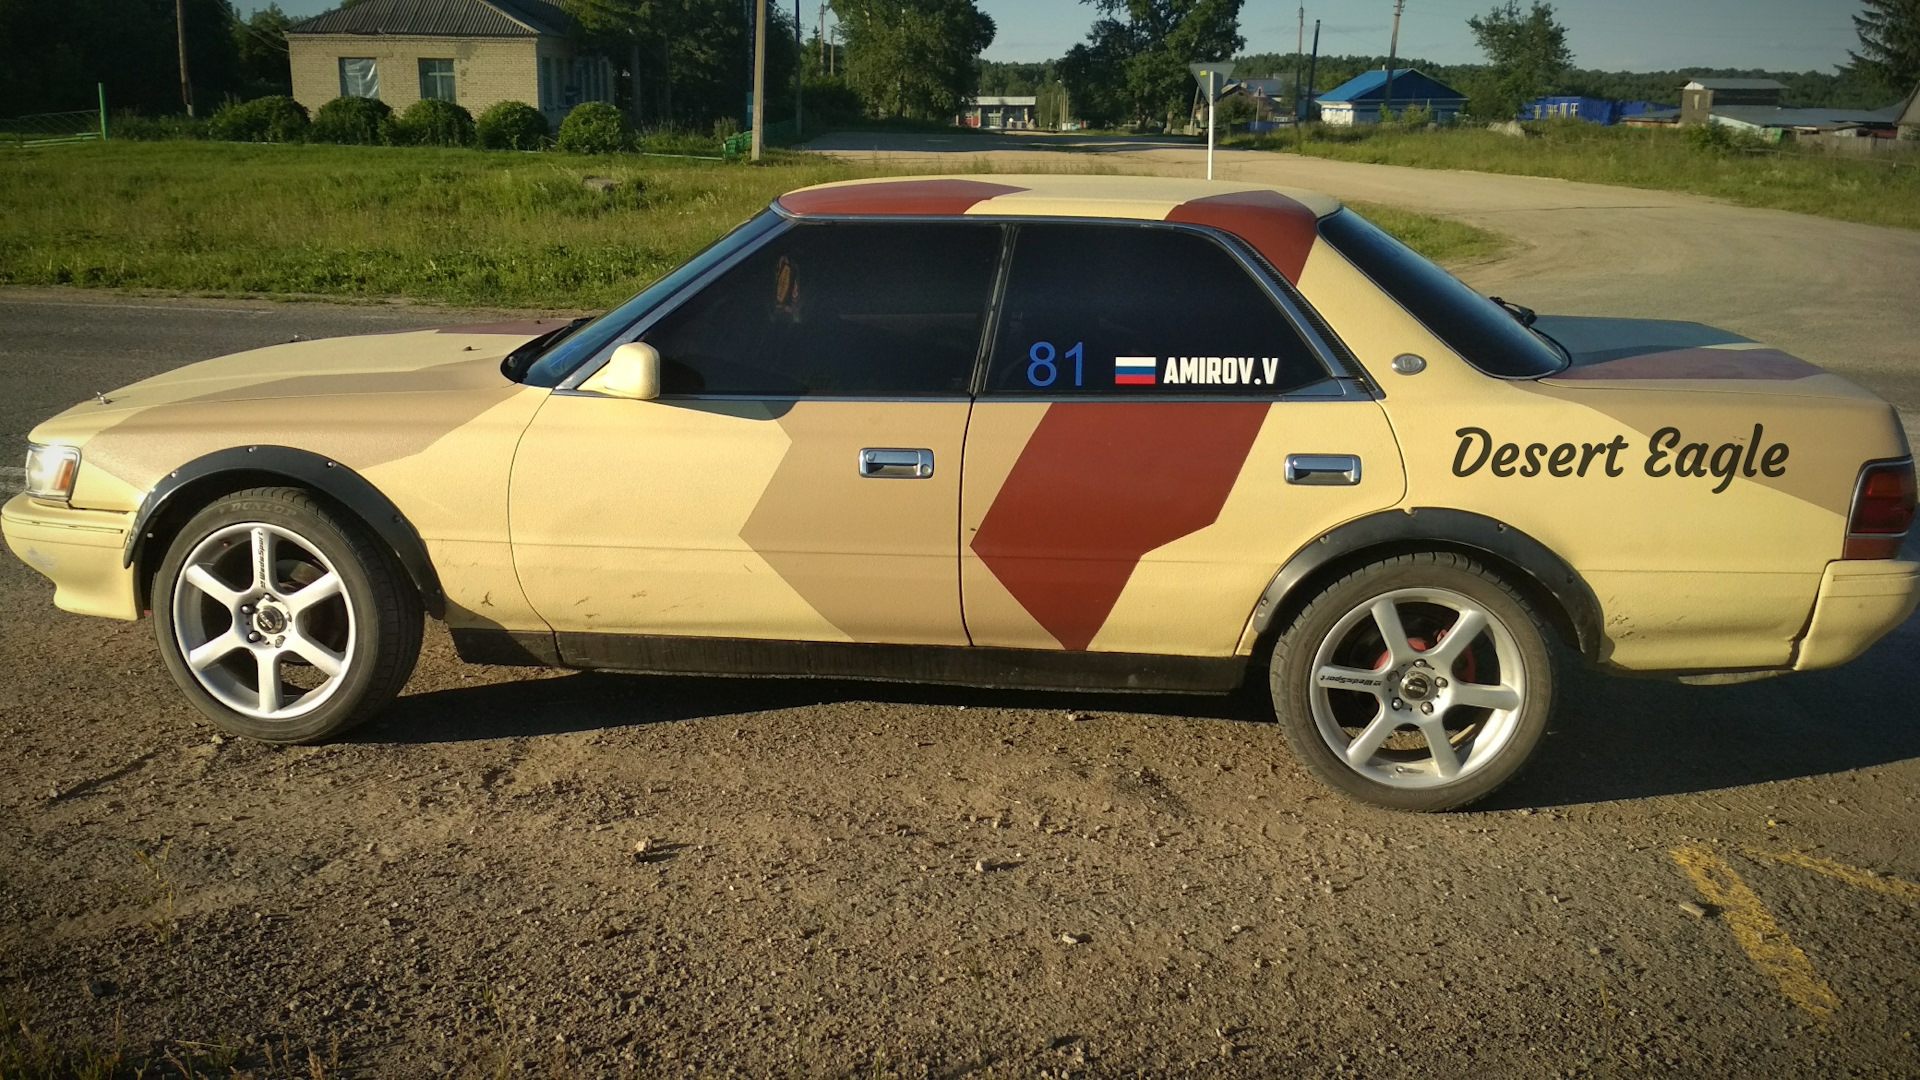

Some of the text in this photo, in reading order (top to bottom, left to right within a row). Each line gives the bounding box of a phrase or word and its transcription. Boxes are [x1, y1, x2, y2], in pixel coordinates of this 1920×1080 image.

[1026, 341, 1083, 387] 81
[1163, 357, 1279, 385] AMIROV.V
[1452, 423, 1790, 494] Desert Eagle
[231, 502, 297, 516] DUNLOP
